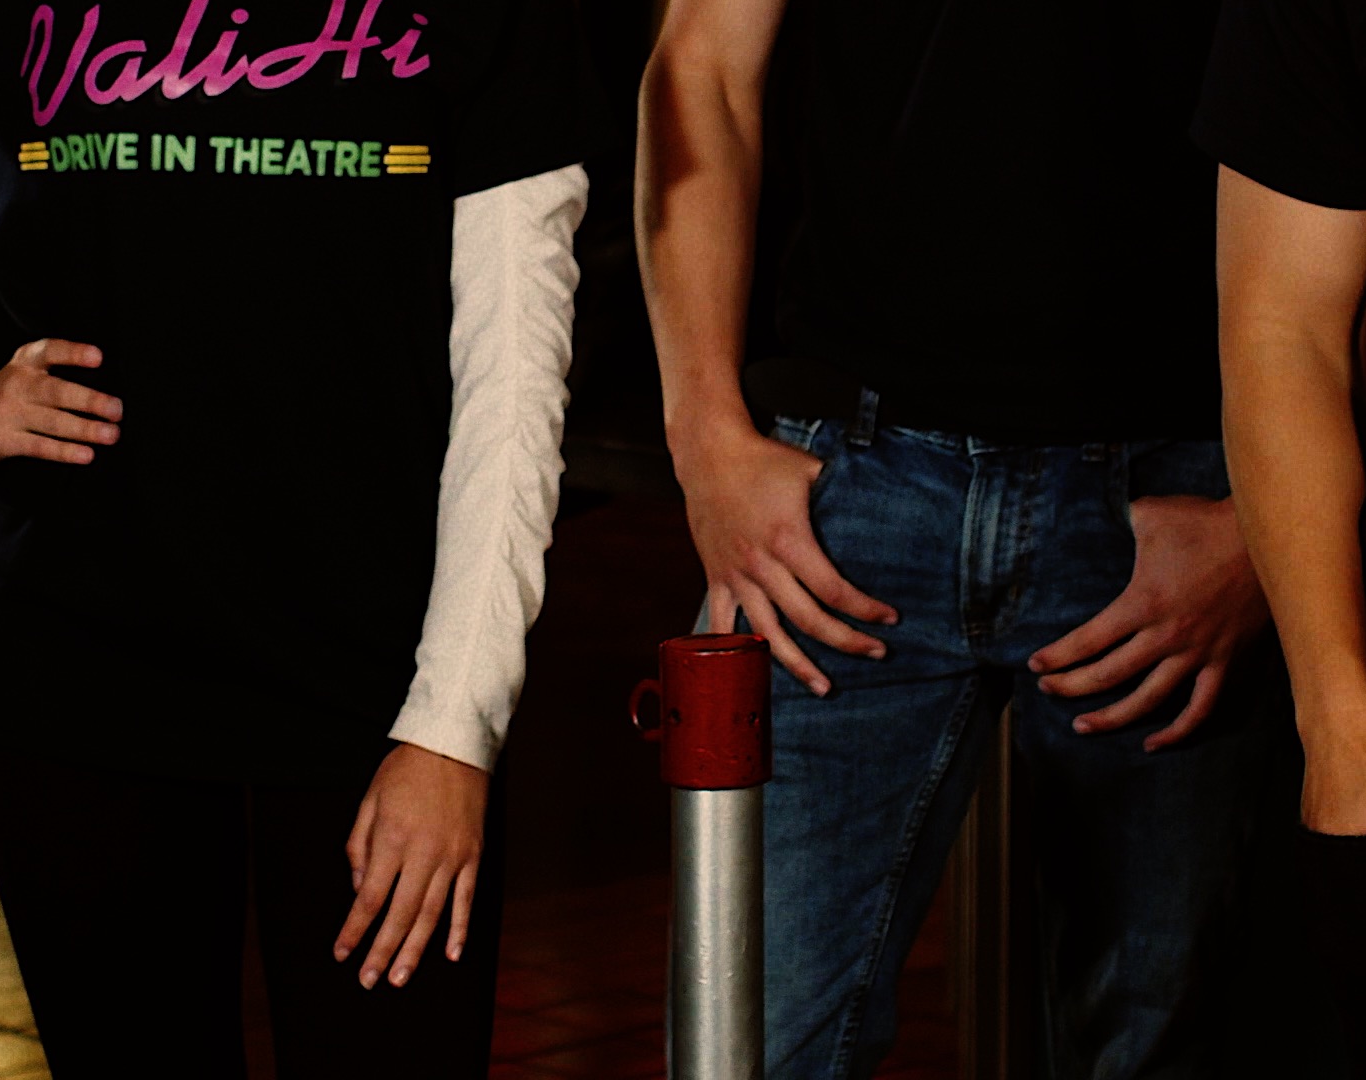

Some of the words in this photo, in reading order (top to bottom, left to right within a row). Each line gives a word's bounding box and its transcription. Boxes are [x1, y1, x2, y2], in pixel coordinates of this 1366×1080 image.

[50, 132, 139, 173] DRIVE
[151, 133, 197, 173] IN
[209, 136, 383, 178] THEATRE
